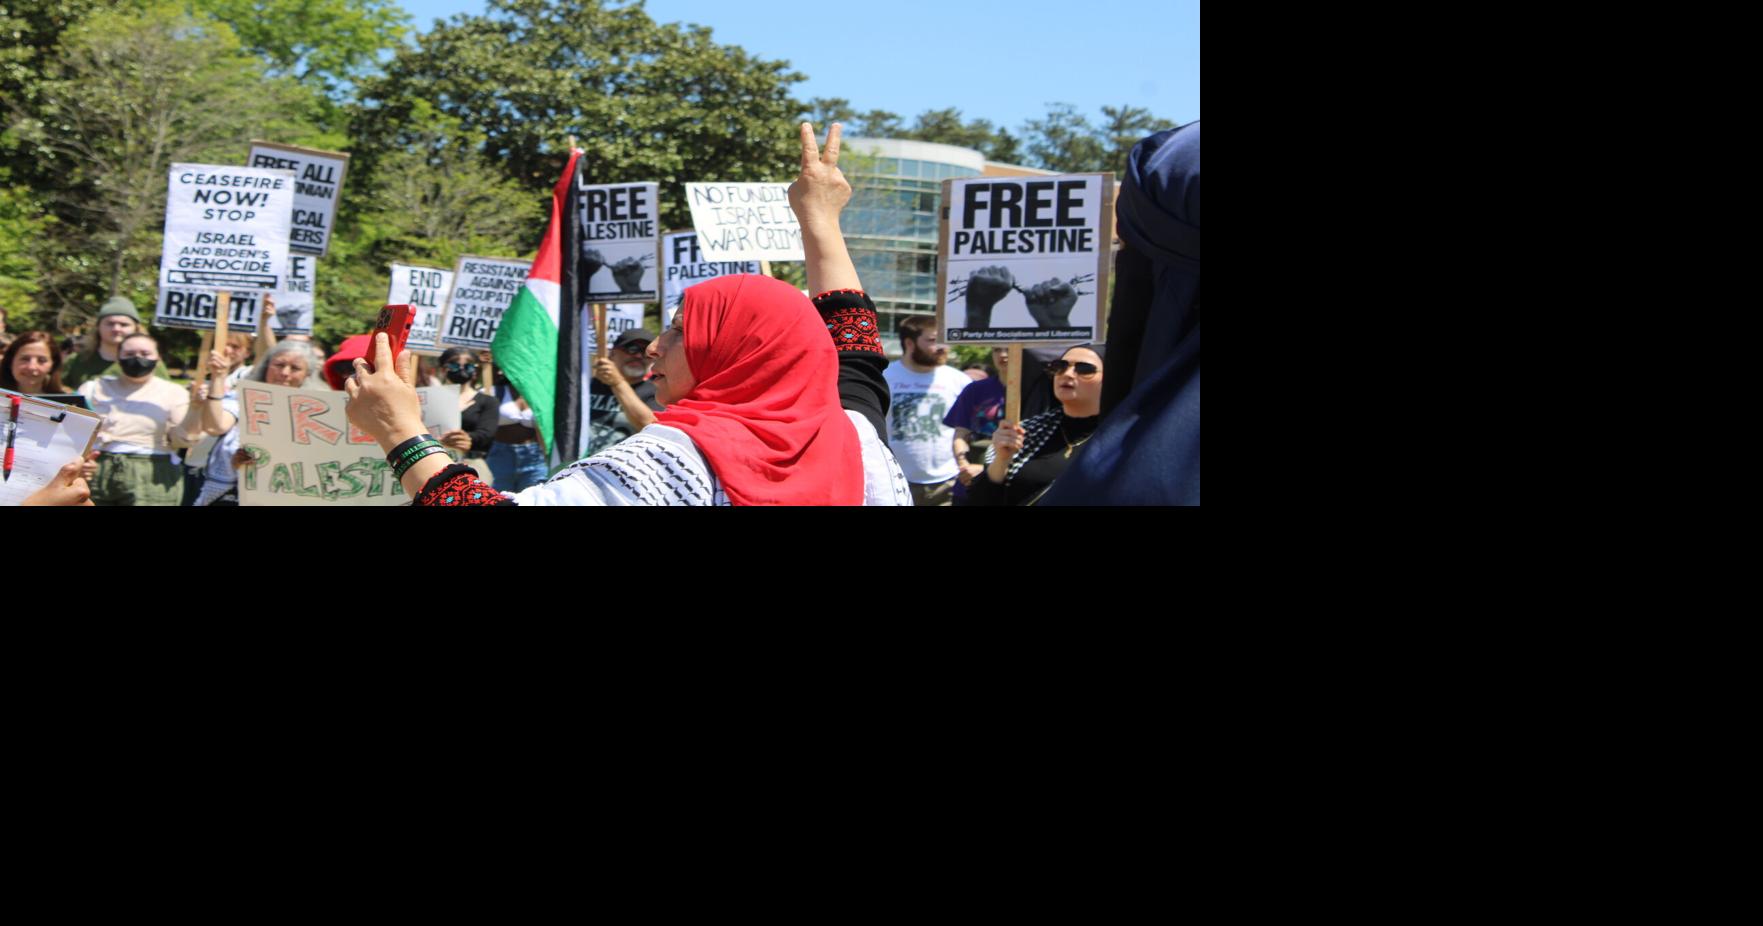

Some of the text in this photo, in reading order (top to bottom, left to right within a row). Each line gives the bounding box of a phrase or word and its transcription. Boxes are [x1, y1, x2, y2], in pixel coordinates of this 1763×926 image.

[180, 172, 284, 190] CEASEFIRE
[302, 164, 335, 184] ALL
[193, 189, 269, 207] NOW!
[694, 186, 788, 206] NO FUNDIN
[963, 180, 1087, 228] FREE
[203, 208, 256, 222] STOP
[711, 206, 782, 226] ISRAEL
[196, 232, 256, 246] ISRAEL
[702, 226, 802, 251] WAR CRIM
[954, 228, 1093, 254] PALESTINE
[180, 246, 270, 260] AND BIDEN'S
[178, 257, 272, 272] GENOCIDE
[464, 262, 530, 280] RESISTANC
[668, 262, 756, 280] PALESTINE
[410, 270, 442, 289] END
[409, 288, 437, 308] ALL
[456, 288, 514, 304] OCCUPAT
[455, 304, 466, 315] IS
[469, 305, 476, 316] A
[424, 313, 438, 329] AI
[449, 316, 498, 340] RIGH
